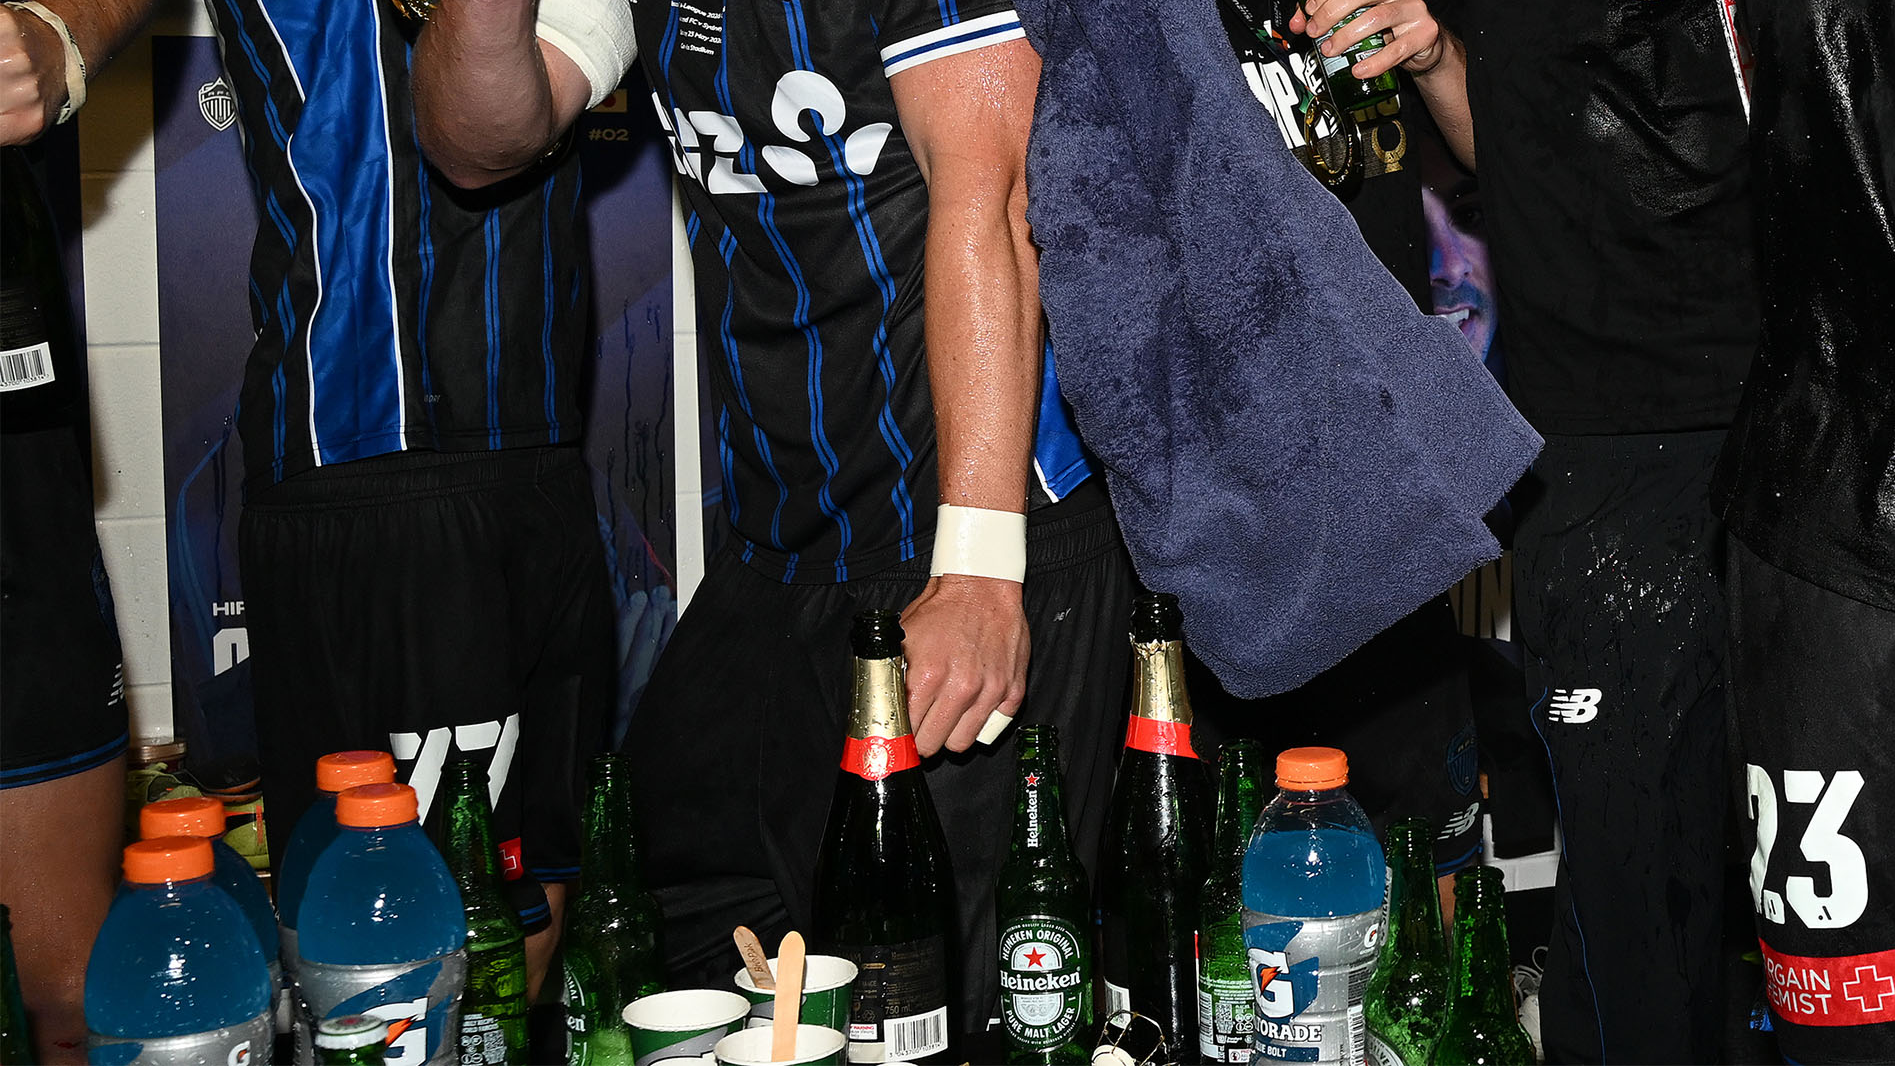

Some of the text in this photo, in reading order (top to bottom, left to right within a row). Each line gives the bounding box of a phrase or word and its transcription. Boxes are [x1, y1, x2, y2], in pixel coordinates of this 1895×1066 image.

[588, 128, 630, 142] #02
[389, 713, 520, 827] 77
[1027, 790, 1039, 848] Heineken
[1747, 763, 1869, 929] 23
[1002, 929, 1074, 961] HEINEKEN ORIGINAL
[1000, 969, 1080, 991] Heineken
[1248, 947, 1295, 1019] G
[1763, 955, 1831, 991] RGAIN
[885, 1005, 900, 1014] 750
[1768, 984, 1832, 1015] EMIST
[1006, 1009, 1023, 1034] PURE
[1024, 1027, 1050, 1039] MALT
[1052, 1006, 1076, 1035] LAGER
[1267, 1044, 1287, 1058] BOLT
